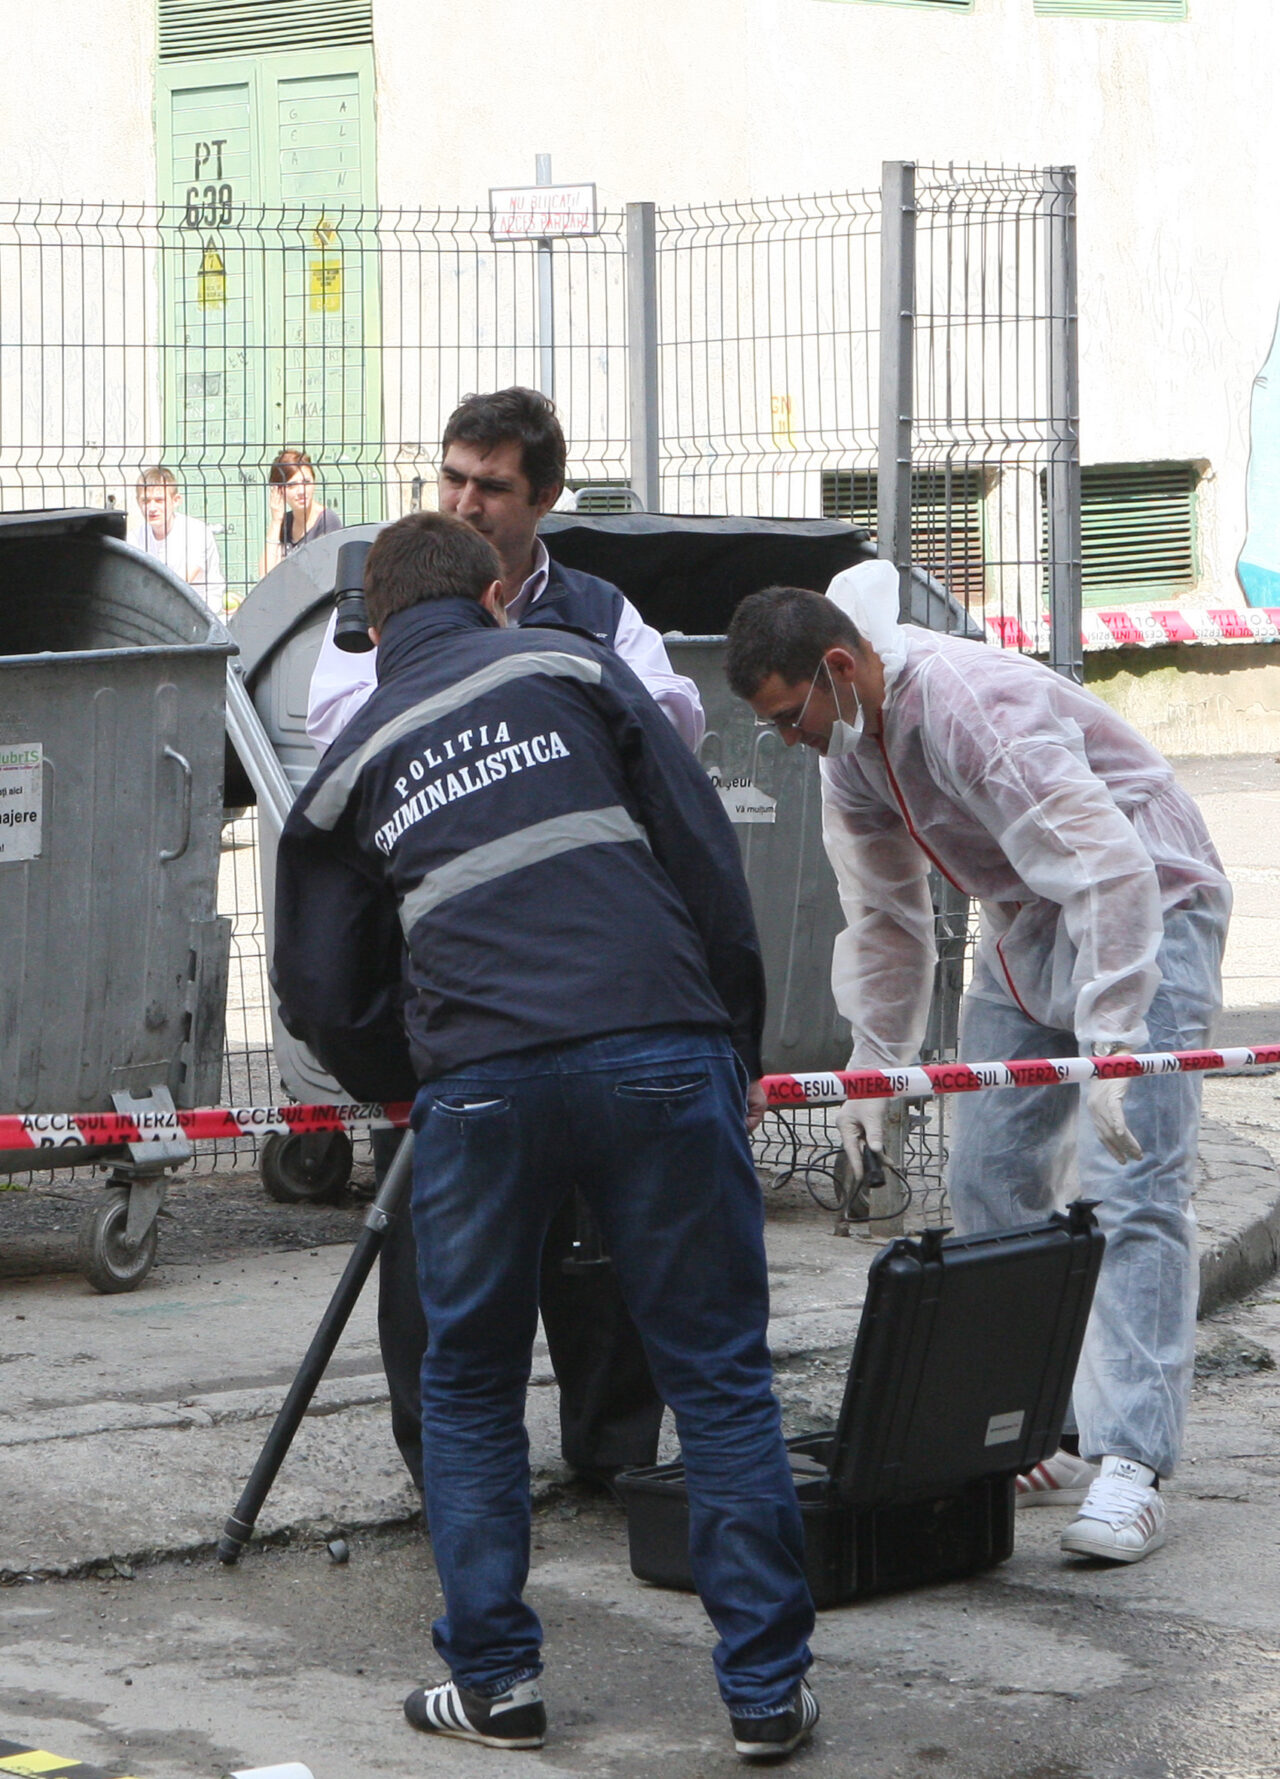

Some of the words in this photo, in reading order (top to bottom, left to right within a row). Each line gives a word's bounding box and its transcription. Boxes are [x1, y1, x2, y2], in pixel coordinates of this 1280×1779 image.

[194, 139, 228, 181] PT
[186, 183, 233, 227] 639
[394, 721, 511, 799] POLITIA
[374, 731, 570, 856] CRIMINALISTICA
[770, 1080, 837, 1099] ACCESUL
[843, 1075, 909, 1096] INTERZIS!
[932, 1070, 1000, 1091] ACCESUL
[1004, 1064, 1069, 1085] INTERZIS!
[1090, 1059, 1155, 1080] ACCESUL
[1160, 1054, 1225, 1073] INTERZIS!
[21, 1112, 108, 1132] ACCESUL
[115, 1110, 196, 1129] INTERZIS!
[222, 1107, 307, 1125] ACCESUL
[311, 1104, 387, 1121] INTERZIS!
